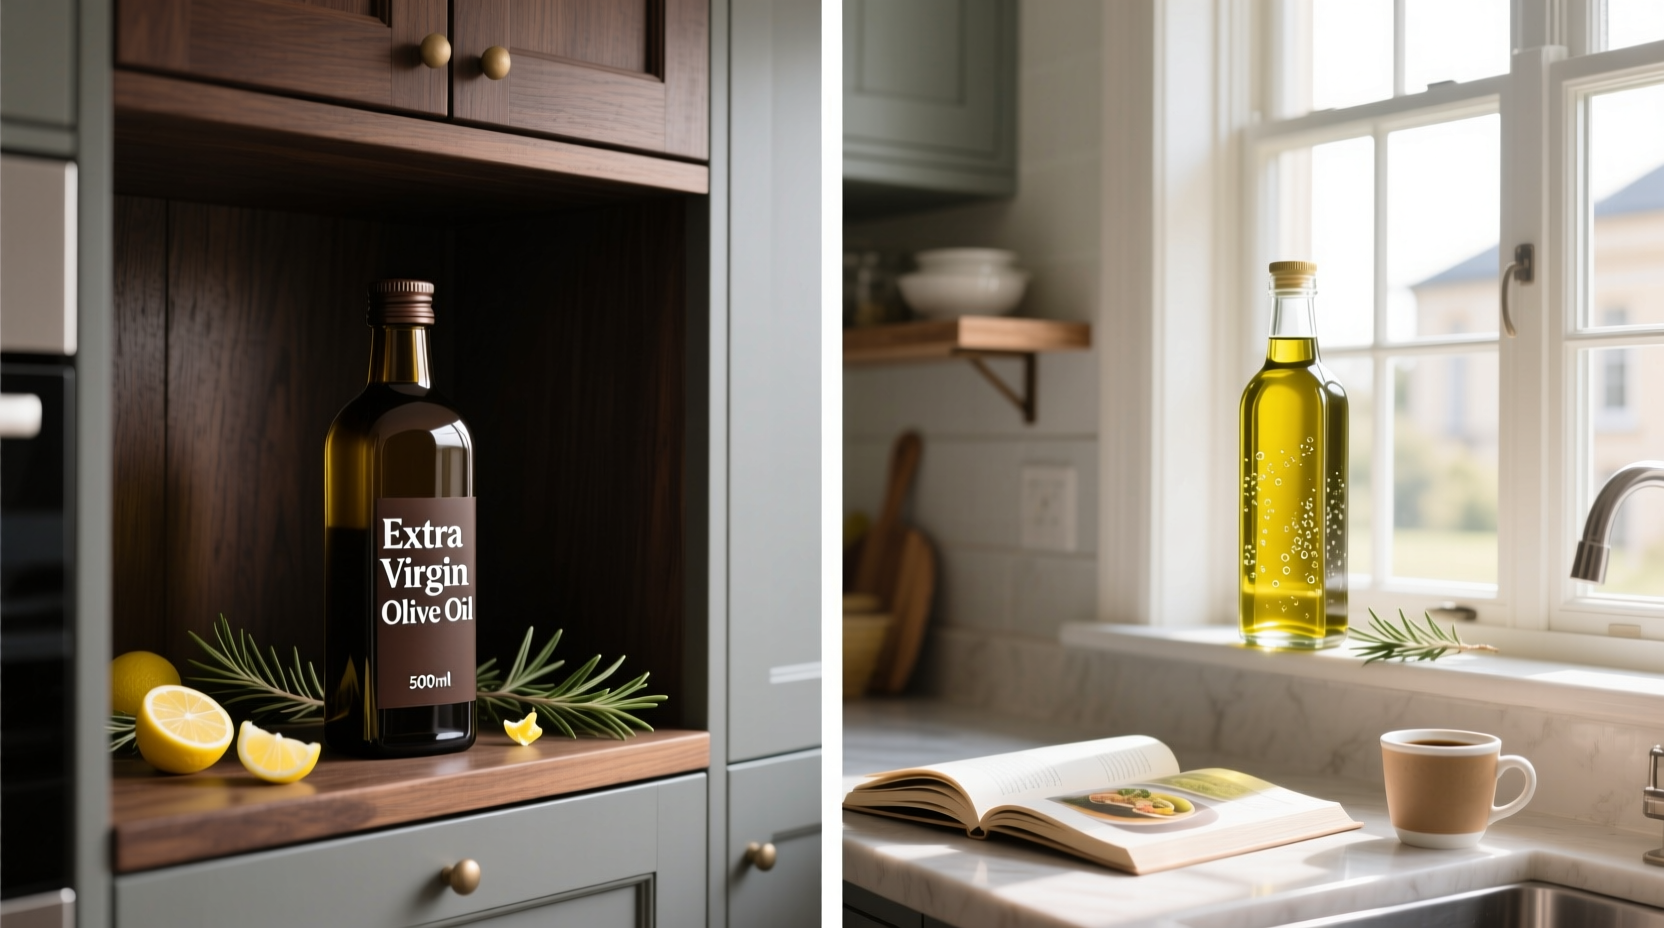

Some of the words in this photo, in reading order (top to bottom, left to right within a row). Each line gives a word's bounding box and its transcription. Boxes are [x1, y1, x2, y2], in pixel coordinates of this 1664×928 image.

[382, 517, 464, 549] Extra
[379, 556, 470, 597] Virgin
[381, 598, 441, 625] Olive
[444, 596, 473, 622] Oil
[409, 670, 452, 690] 500ml
